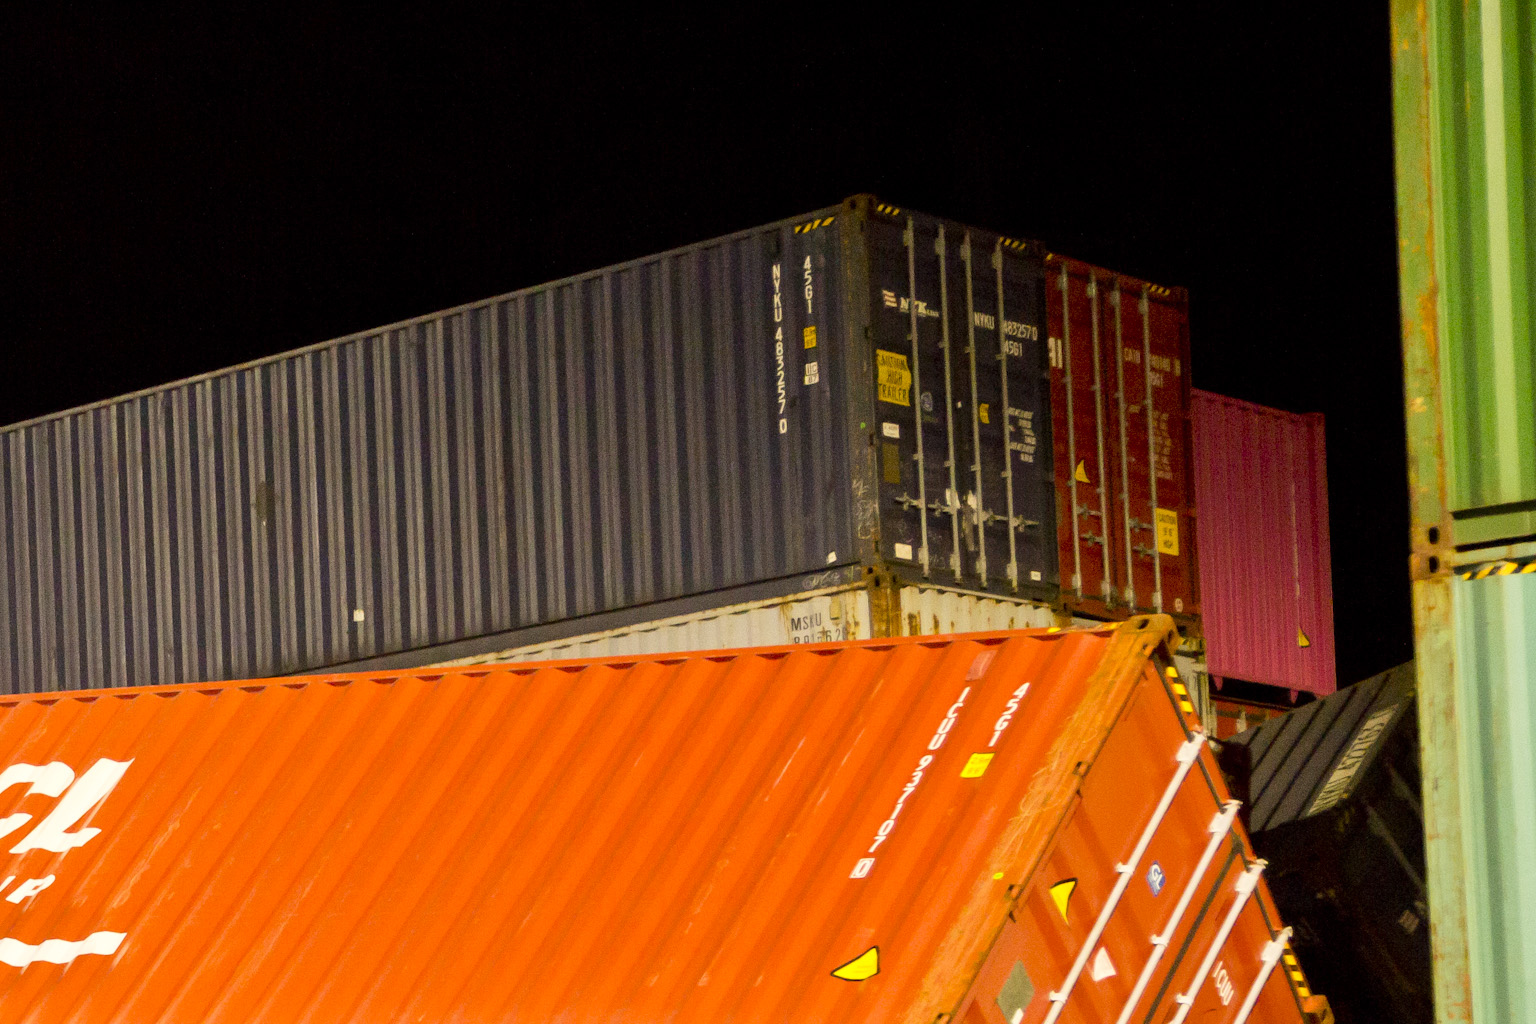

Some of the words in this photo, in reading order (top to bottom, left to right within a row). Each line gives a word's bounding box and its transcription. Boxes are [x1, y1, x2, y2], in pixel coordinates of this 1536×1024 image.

[772, 264, 783, 322] NYKU
[803, 255, 813, 314] 45G1
[974, 312, 995, 331] NYKU
[775, 327, 786, 415] 483257
[791, 612, 822, 631] MSKU
[927, 686, 971, 751] ICUU
[988, 682, 1031, 747] 45G1
[868, 755, 934, 853] 937107
[849, 857, 876, 879] 0
[1213, 961, 1244, 1006] ICUU
